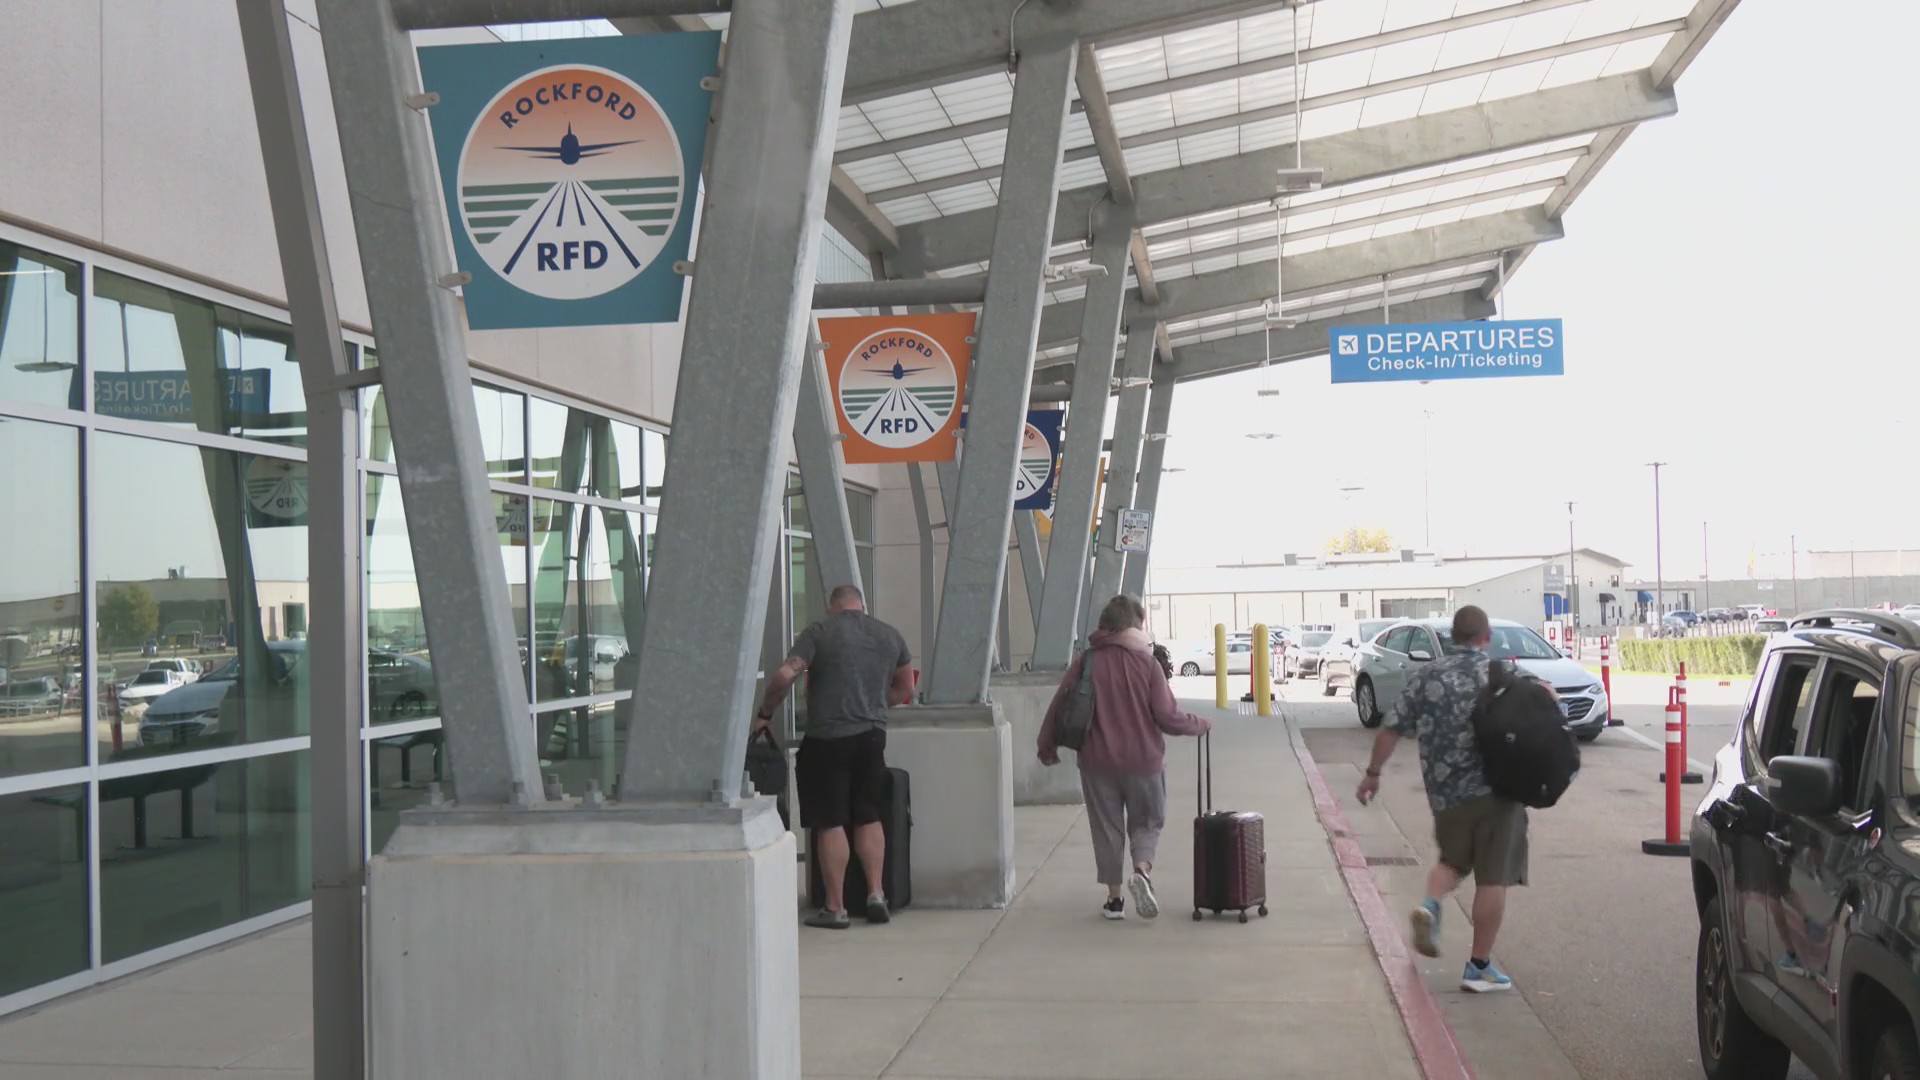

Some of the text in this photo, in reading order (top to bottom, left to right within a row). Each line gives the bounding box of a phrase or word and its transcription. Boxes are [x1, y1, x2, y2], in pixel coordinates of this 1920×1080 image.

[500, 83, 637, 129] ROCKFORD
[537, 240, 609, 272] RFD
[861, 337, 933, 360] ROCKFORD
[1367, 327, 1555, 354] DEPARTURES
[1367, 352, 1542, 371] Check-In/Ticketing
[881, 418, 919, 434] RFD
